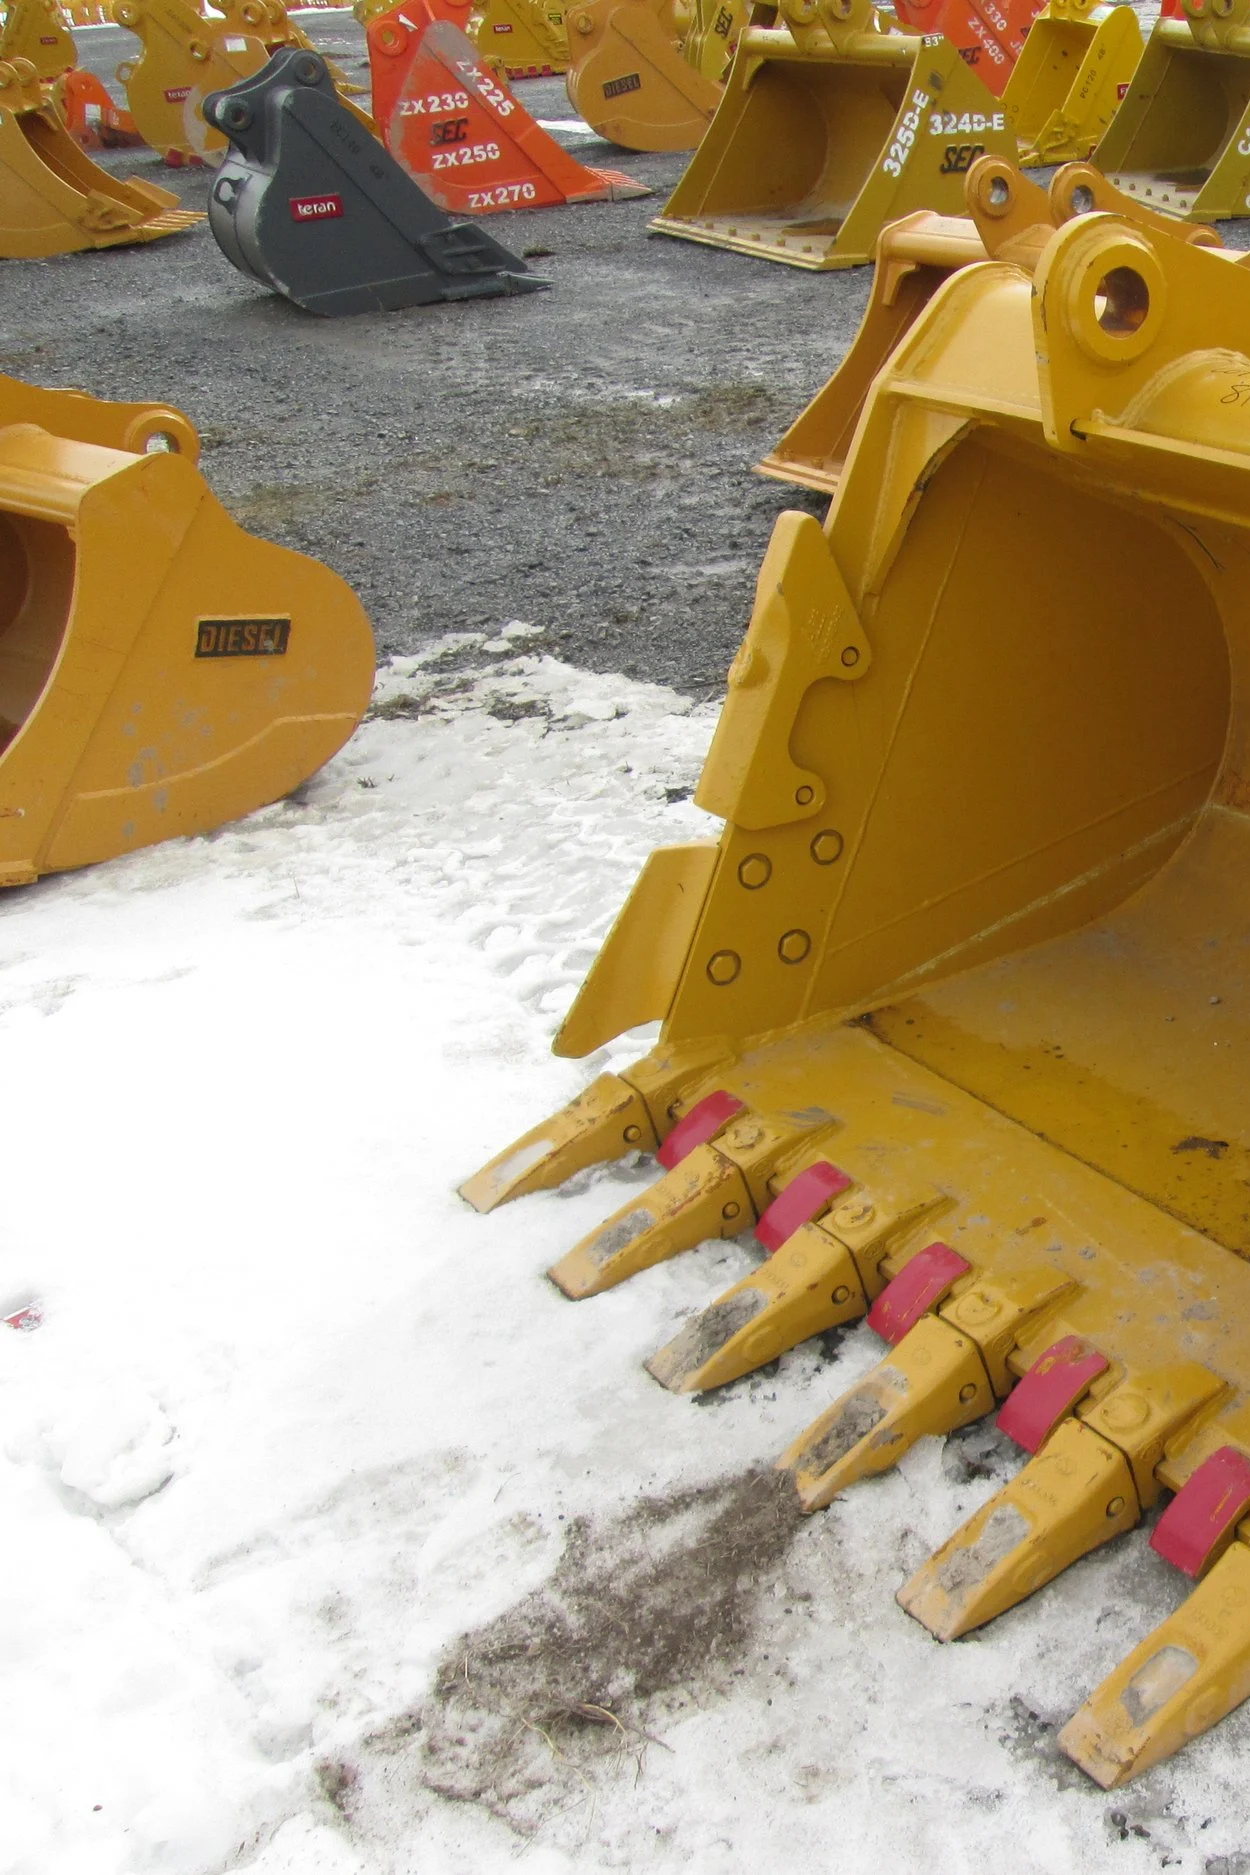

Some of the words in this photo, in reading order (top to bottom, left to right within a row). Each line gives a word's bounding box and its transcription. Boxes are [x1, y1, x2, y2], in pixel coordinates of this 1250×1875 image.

[715, 6, 733, 39] SEC
[968, 16, 1005, 64] ZX400
[456, 58, 515, 116] ZX225
[400, 92, 469, 116] ZX230
[431, 118, 469, 146] SEC
[882, 89, 930, 177] 325D-E
[929, 113, 1005, 135] 324D-E
[432, 143, 500, 169] ZX250
[298, 201, 336, 216] teran
[468, 183, 536, 208] ZX270
[200, 623, 285, 653] DIESEL
